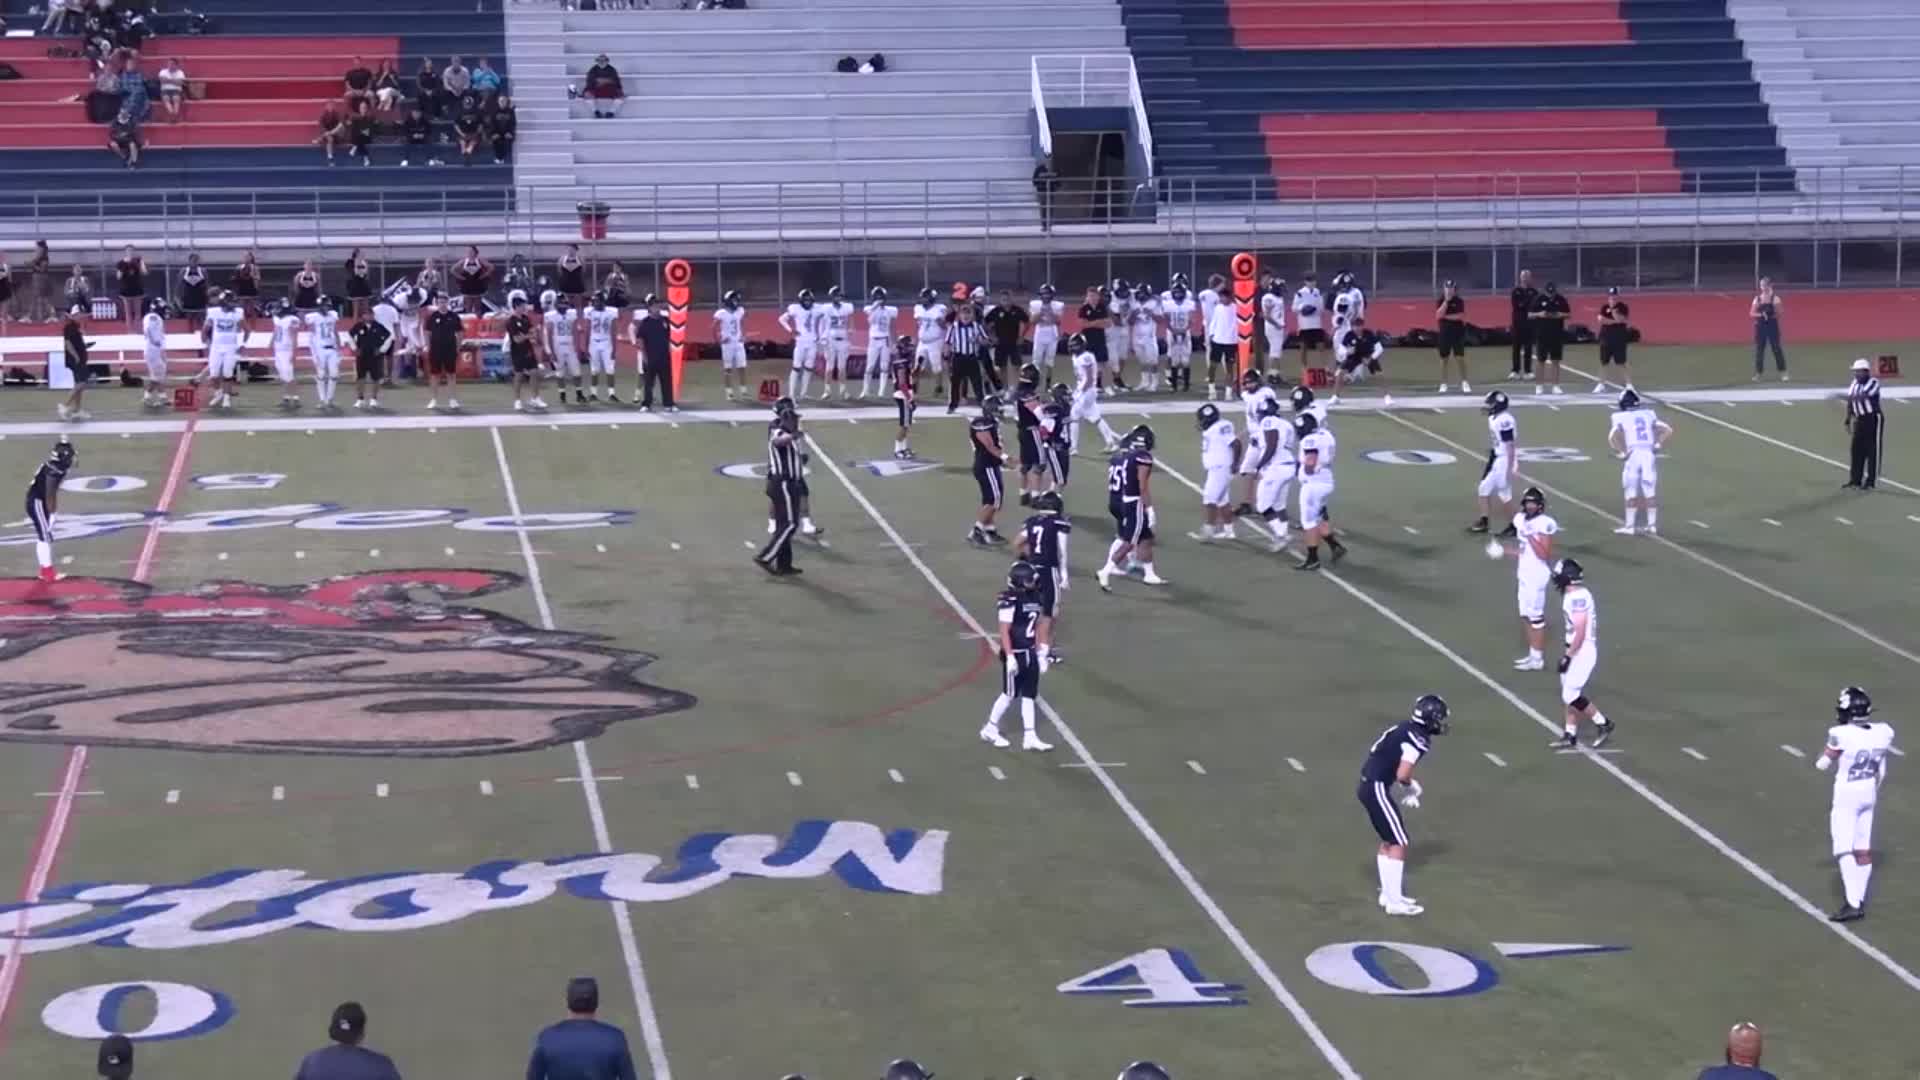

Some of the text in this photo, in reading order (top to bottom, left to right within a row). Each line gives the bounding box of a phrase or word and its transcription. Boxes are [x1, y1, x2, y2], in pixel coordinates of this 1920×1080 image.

[1634, 415, 1650, 442] 2
[1032, 526, 1045, 554] 7
[1024, 611, 1038, 639] 2
